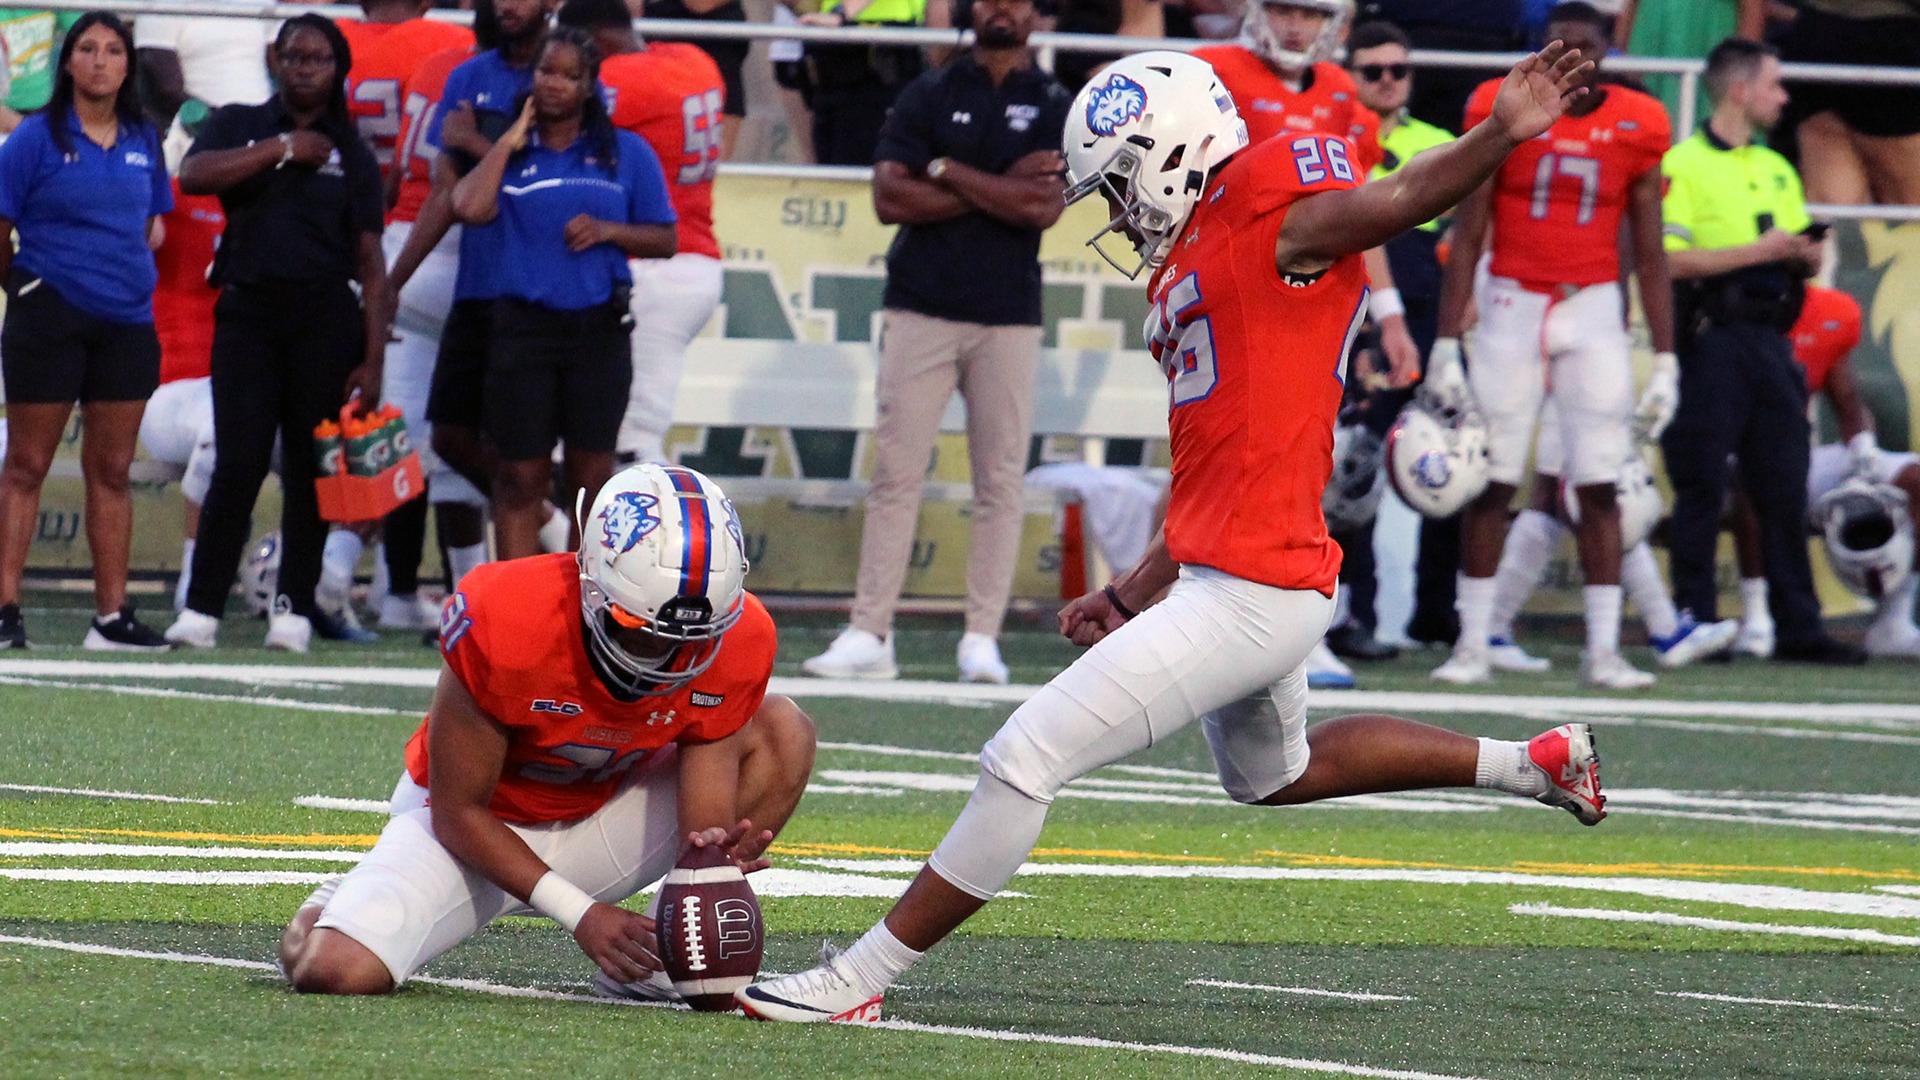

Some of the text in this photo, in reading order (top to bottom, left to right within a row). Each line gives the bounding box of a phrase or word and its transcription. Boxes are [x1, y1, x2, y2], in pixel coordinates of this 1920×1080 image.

[344, 78, 400, 165] 2
[1291, 136, 1355, 186] 26
[1530, 151, 1600, 226] 17
[393, 467, 410, 500] G
